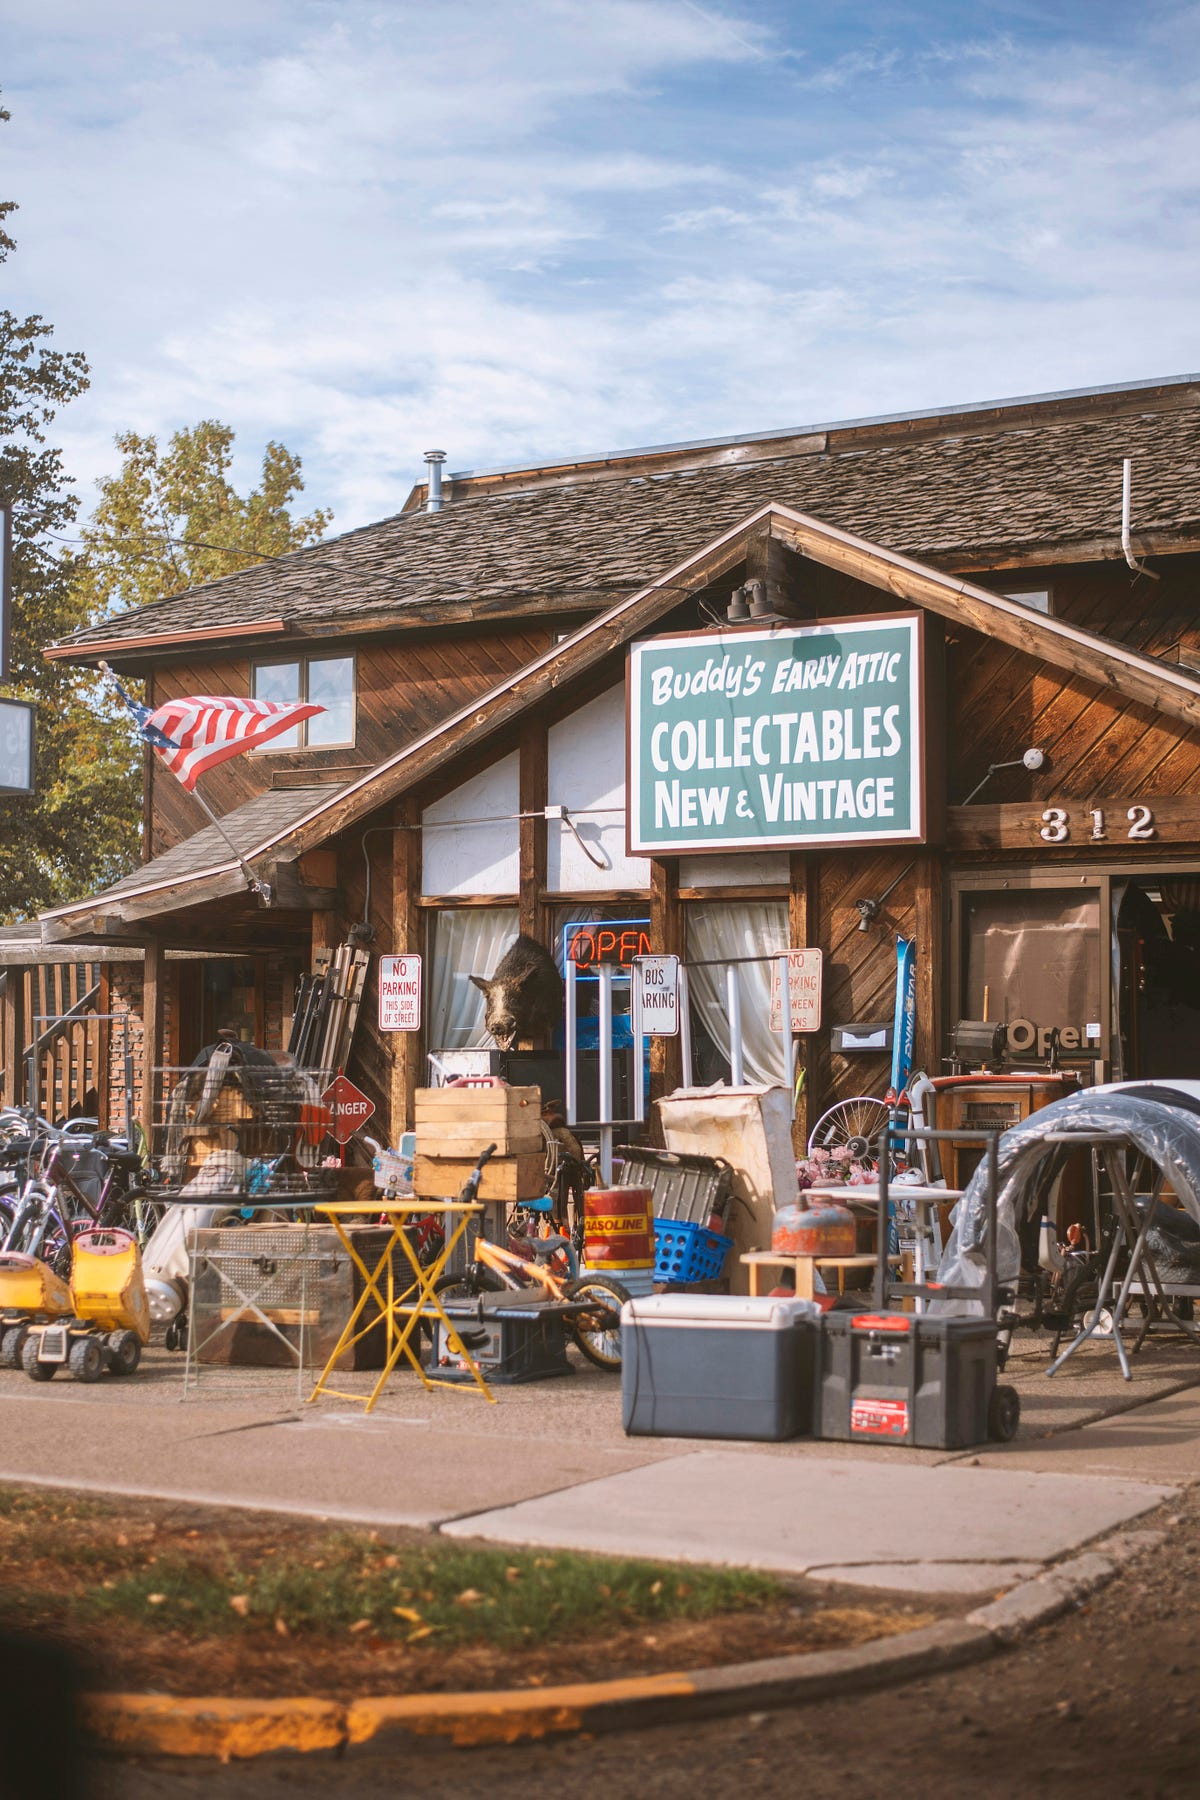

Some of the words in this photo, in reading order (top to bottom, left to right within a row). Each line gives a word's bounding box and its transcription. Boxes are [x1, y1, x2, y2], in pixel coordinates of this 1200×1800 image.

[771, 654, 843, 694] EARLY
[837, 651, 901, 690] ATTIC
[651, 704, 902, 773] COLLECTABLES
[654, 779, 730, 829] NEW
[735, 789, 755, 819] &
[759, 773, 894, 823] VINTAGE
[571, 931, 653, 969] OPEN
[788, 953, 805, 968] NO
[392, 962, 407, 977] NO
[645, 969, 664, 985] BUS
[382, 981, 417, 996] PARKING
[775, 975, 817, 991] PRKING
[385, 1000, 398, 1011] THIS
[401, 1000, 414, 1011] SIDE
[642, 992, 675, 1009] ARKING
[776, 999, 815, 1010] BWEEN
[384, 1013, 392, 1023] OF
[394, 1013, 415, 1023] STREET
[904, 963, 917, 1060] DYNATAR
[329, 1101, 368, 1115] ANGER
[585, 1218, 644, 1231] GASOLINE
